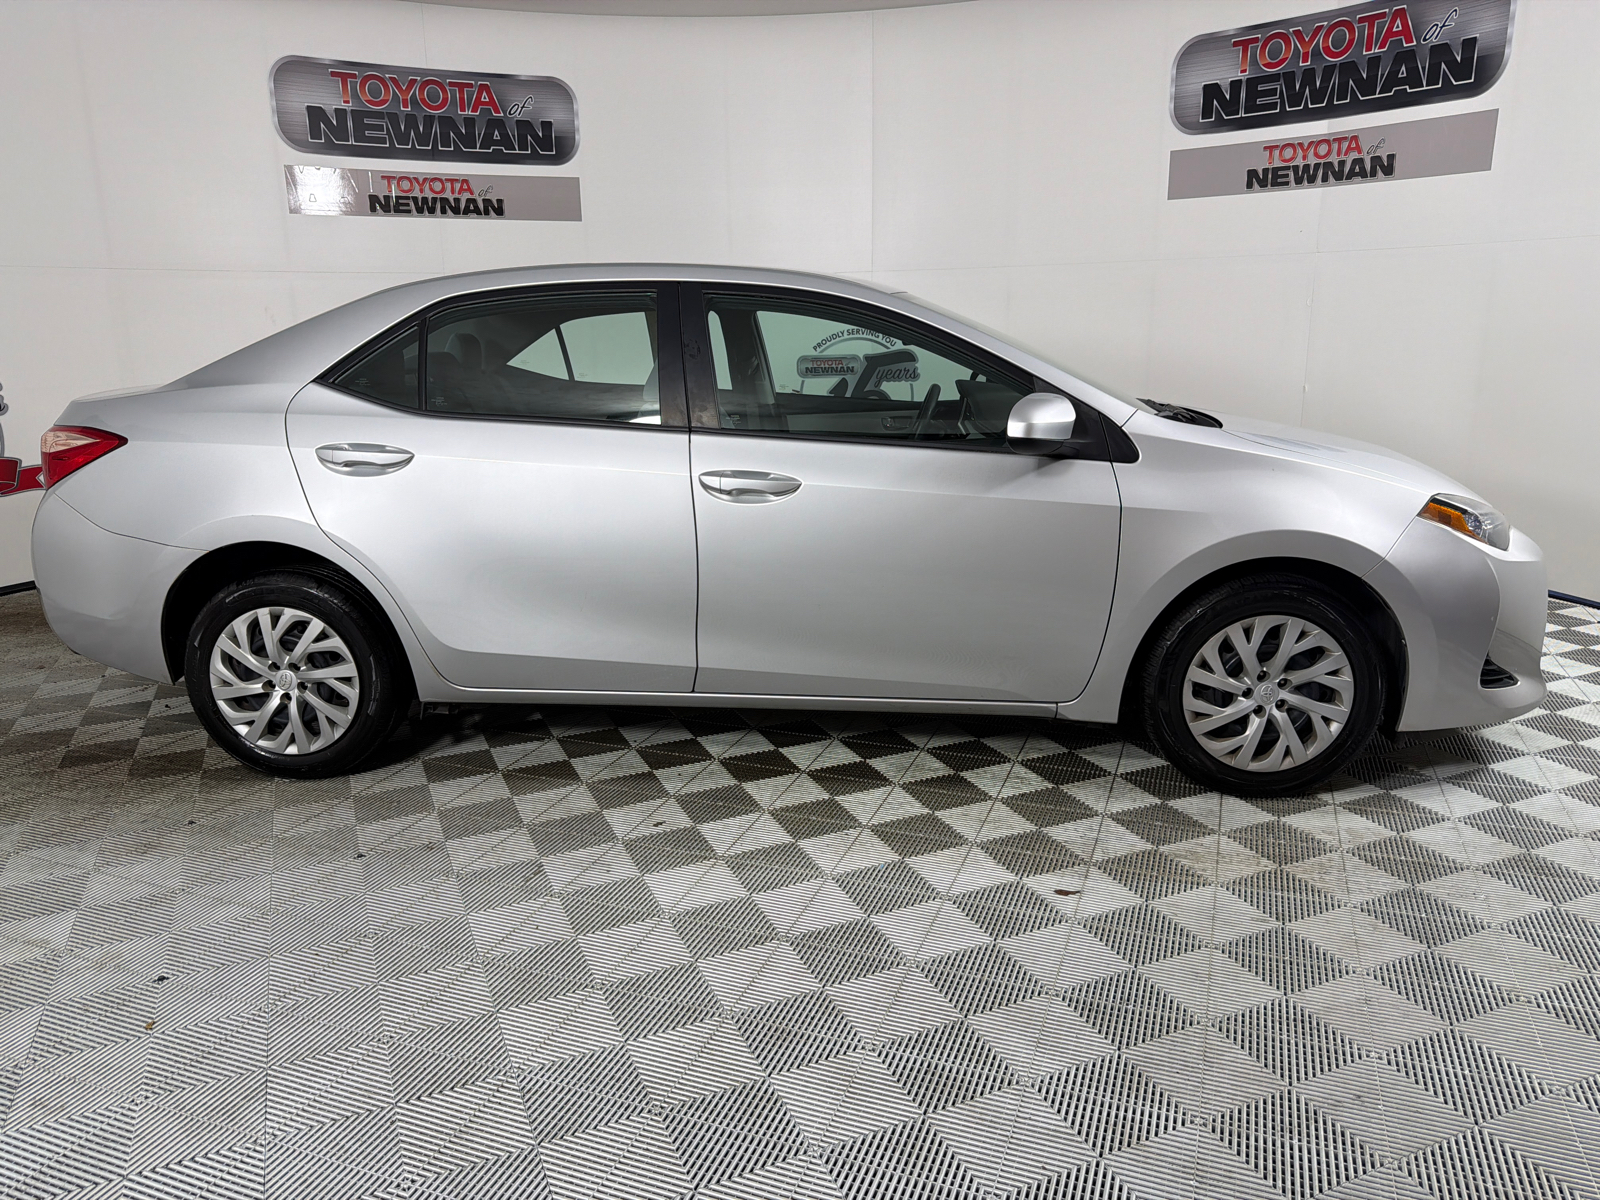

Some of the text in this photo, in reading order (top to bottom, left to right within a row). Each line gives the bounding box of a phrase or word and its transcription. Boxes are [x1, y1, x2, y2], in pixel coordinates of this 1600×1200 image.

[1231, 4, 1459, 75] TOYOTA of
[1200, 35, 1480, 122] NEWNAN
[329, 69, 534, 118] TOYOTA of
[305, 104, 556, 154] NEWNAN
[1263, 134, 1386, 166] TOYOTA of
[1246, 152, 1397, 190] NEWNAN
[381, 175, 494, 197] TOYOTA of
[368, 194, 505, 217] NEWNAN
[812, 328, 897, 352] PROUDLY SERVING YOU
[805, 366, 854, 374] NEWNAN
[810, 359, 844, 367] TOYOTA
[874, 366, 919, 388] years
